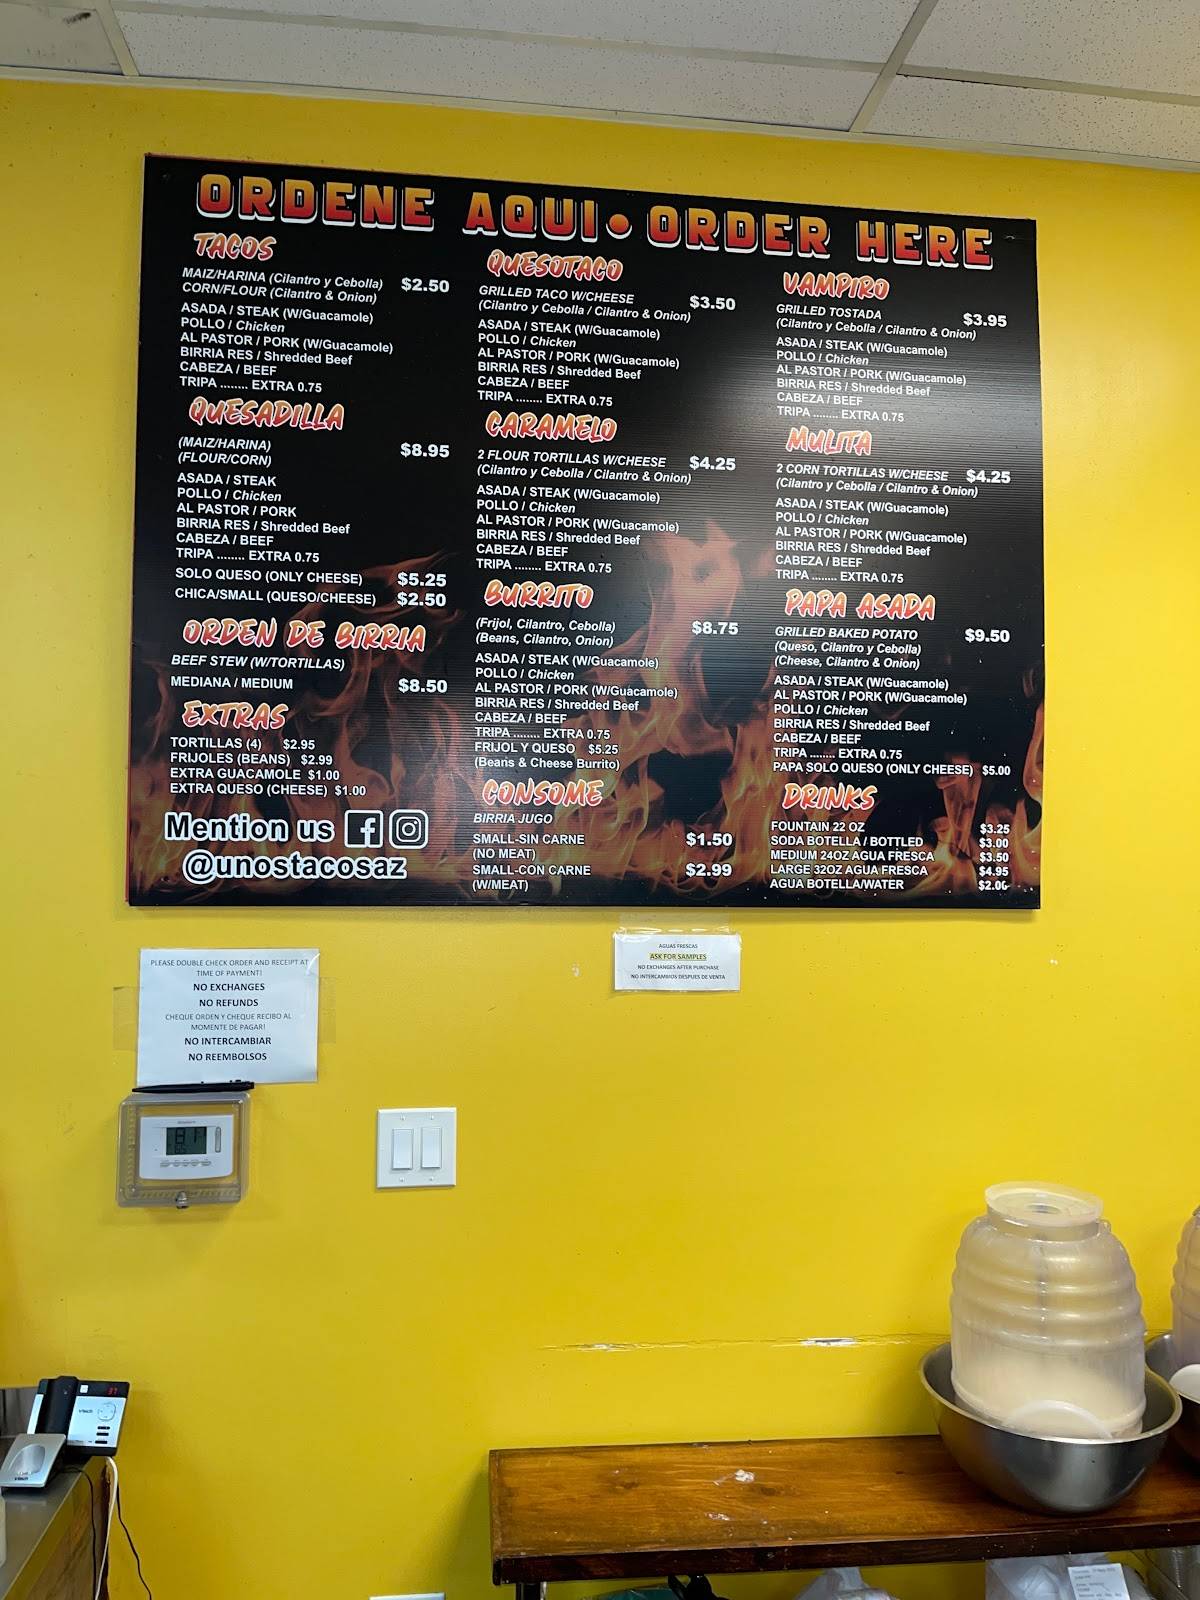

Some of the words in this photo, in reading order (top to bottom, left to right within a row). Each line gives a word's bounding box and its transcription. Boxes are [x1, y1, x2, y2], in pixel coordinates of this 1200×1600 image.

[196, 173, 435, 232] ORDENE
[462, 192, 599, 243] AQUI
[647, 205, 830, 259] ORDER
[855, 220, 993, 270] HERE
[194, 232, 276, 260] TACOS
[487, 249, 623, 281] QUESOTACO
[182, 267, 265, 282] MAIZ/HARINA
[269, 273, 320, 285] (Cilantro
[324, 278, 331, 288] y
[335, 276, 382, 291] Cebolla)
[401, 277, 449, 292] $2.50
[783, 272, 889, 300] VAMPIRO
[479, 285, 531, 297] GRILLED
[536, 288, 567, 299] TACO
[571, 291, 634, 304] W/CHEESE
[690, 295, 735, 310] $3.50
[776, 304, 826, 315] GRILLED
[829, 307, 881, 319] TOSTADA
[181, 317, 224, 329] POLLO
[228, 320, 232, 329] /
[236, 320, 284, 332] Chicken
[963, 312, 1007, 327] $3.95
[478, 347, 494, 357] AL
[498, 348, 546, 360] PASTOR
[549, 351, 553, 360] /
[556, 351, 590, 362] PORK
[594, 353, 679, 369] (W/Guacamole)
[189, 396, 344, 430] QUESADILLA
[485, 410, 617, 443] CARAMELO
[178, 436, 270, 452] (MAIZ/HARINA)
[786, 426, 871, 456] MULITA
[400, 442, 449, 457] $8.95
[178, 452, 271, 467] (FLOUR/CORN)
[477, 449, 484, 459] 2
[487, 450, 529, 461] FLOUR
[533, 452, 599, 464] TORTILLAS
[603, 455, 666, 467] W/CHEESE
[689, 455, 735, 471] $4.25
[966, 469, 1010, 483] $4.25
[397, 571, 446, 586] $5.25
[175, 588, 263, 600] CHICA/SMALL
[267, 591, 375, 606] (QUESO/CHEESE)
[397, 591, 446, 606] $2.50
[484, 579, 593, 608] BURRITO
[785, 588, 846, 618] PAPA
[855, 592, 935, 621] ASADA
[476, 617, 512, 630] (Frijol,
[517, 618, 564, 631] Cilantro,
[569, 620, 615, 633] Cebolla)
[692, 620, 739, 635] $8.75
[183, 617, 277, 648] ORDEN
[286, 620, 325, 648] DE
[334, 622, 425, 652] BIRRIA
[775, 626, 825, 637] GRILLED
[828, 628, 869, 638] BAKED
[872, 629, 918, 640] POTATO
[965, 628, 1010, 643] $9.50
[398, 678, 447, 693] $8.50
[182, 700, 289, 730] EXTRAS
[170, 737, 242, 748] TORTILLAS
[246, 738, 261, 751] (4)
[283, 738, 315, 750] $2.95
[475, 741, 518, 752] FRIJOL
[520, 742, 529, 752] Y
[532, 742, 575, 753] QUESO
[588, 744, 618, 755] $5.25
[171, 752, 233, 763] FRIJOLES
[237, 753, 290, 766] (BEANS)
[301, 754, 332, 765] $2.99
[170, 767, 214, 778] EXTRA
[217, 768, 301, 779] GUACAMOLE
[308, 769, 339, 780] $1.00
[773, 762, 803, 772] PAPA
[806, 762, 838, 772] SOLO
[841, 763, 883, 773] QUESO
[886, 763, 920, 775] (ONLY
[923, 764, 973, 777] CHEESE)
[982, 765, 1010, 776] $5.00
[482, 777, 604, 807] CONSOME
[782, 782, 877, 810] DRINKS
[473, 813, 515, 823] BIRRIA
[517, 813, 553, 824] JUGO
[164, 811, 288, 842] Mention
[297, 819, 335, 842] us
[771, 821, 829, 831] FOUNTAIN
[833, 822, 845, 831] 22
[849, 822, 865, 832] OZ
[980, 823, 1009, 834] $3.25
[472, 833, 538, 844] SMALL-SIN
[542, 834, 584, 844] CARNE
[686, 832, 732, 847] $1.50
[473, 848, 495, 860] (NO
[499, 848, 535, 861] MEAT)
[771, 850, 817, 860] MEDIUM
[820, 850, 849, 860] 24OZ
[852, 850, 885, 860] AGUA
[888, 851, 934, 861] FRESCA
[979, 852, 1009, 863] $3.50
[182, 848, 407, 884] @unostacosaz
[472, 865, 544, 875] SMALL-CON
[548, 865, 590, 875] CARNE
[686, 863, 731, 877] $2.99
[472, 879, 528, 892] (W/MEAT)
[770, 878, 804, 888] AGUA
[807, 879, 904, 889] BOTELLA/WATER
[151, 959, 175, 967] PLEASE
[176, 959, 204, 967] DOUBLE
[205, 959, 228, 967] CHECK
[229, 959, 253, 967] ORDER
[255, 959, 270, 967] AND
[271, 959, 299, 967] RECEIPT
[300, 959, 309, 967] AT
[193, 983, 208, 991] NO
[210, 983, 265, 991] EXCHANGES
[199, 999, 214, 1007] NO
[216, 999, 259, 1007] REFUNDS
[165, 1013, 194, 1021] CHEQUE
[196, 1013, 220, 1021] ORDEN
[221, 1013, 225, 1021] Y
[227, 1013, 255, 1021] CHEQUE
[256, 1013, 282, 1021] RECIBO
[283, 1013, 291, 1021] AL
[184, 1037, 199, 1045] NO
[201, 1037, 271, 1045] INTERCAMBIAR
[188, 1053, 203, 1061] NO
[205, 1053, 267, 1061] REEMBOLSOS
